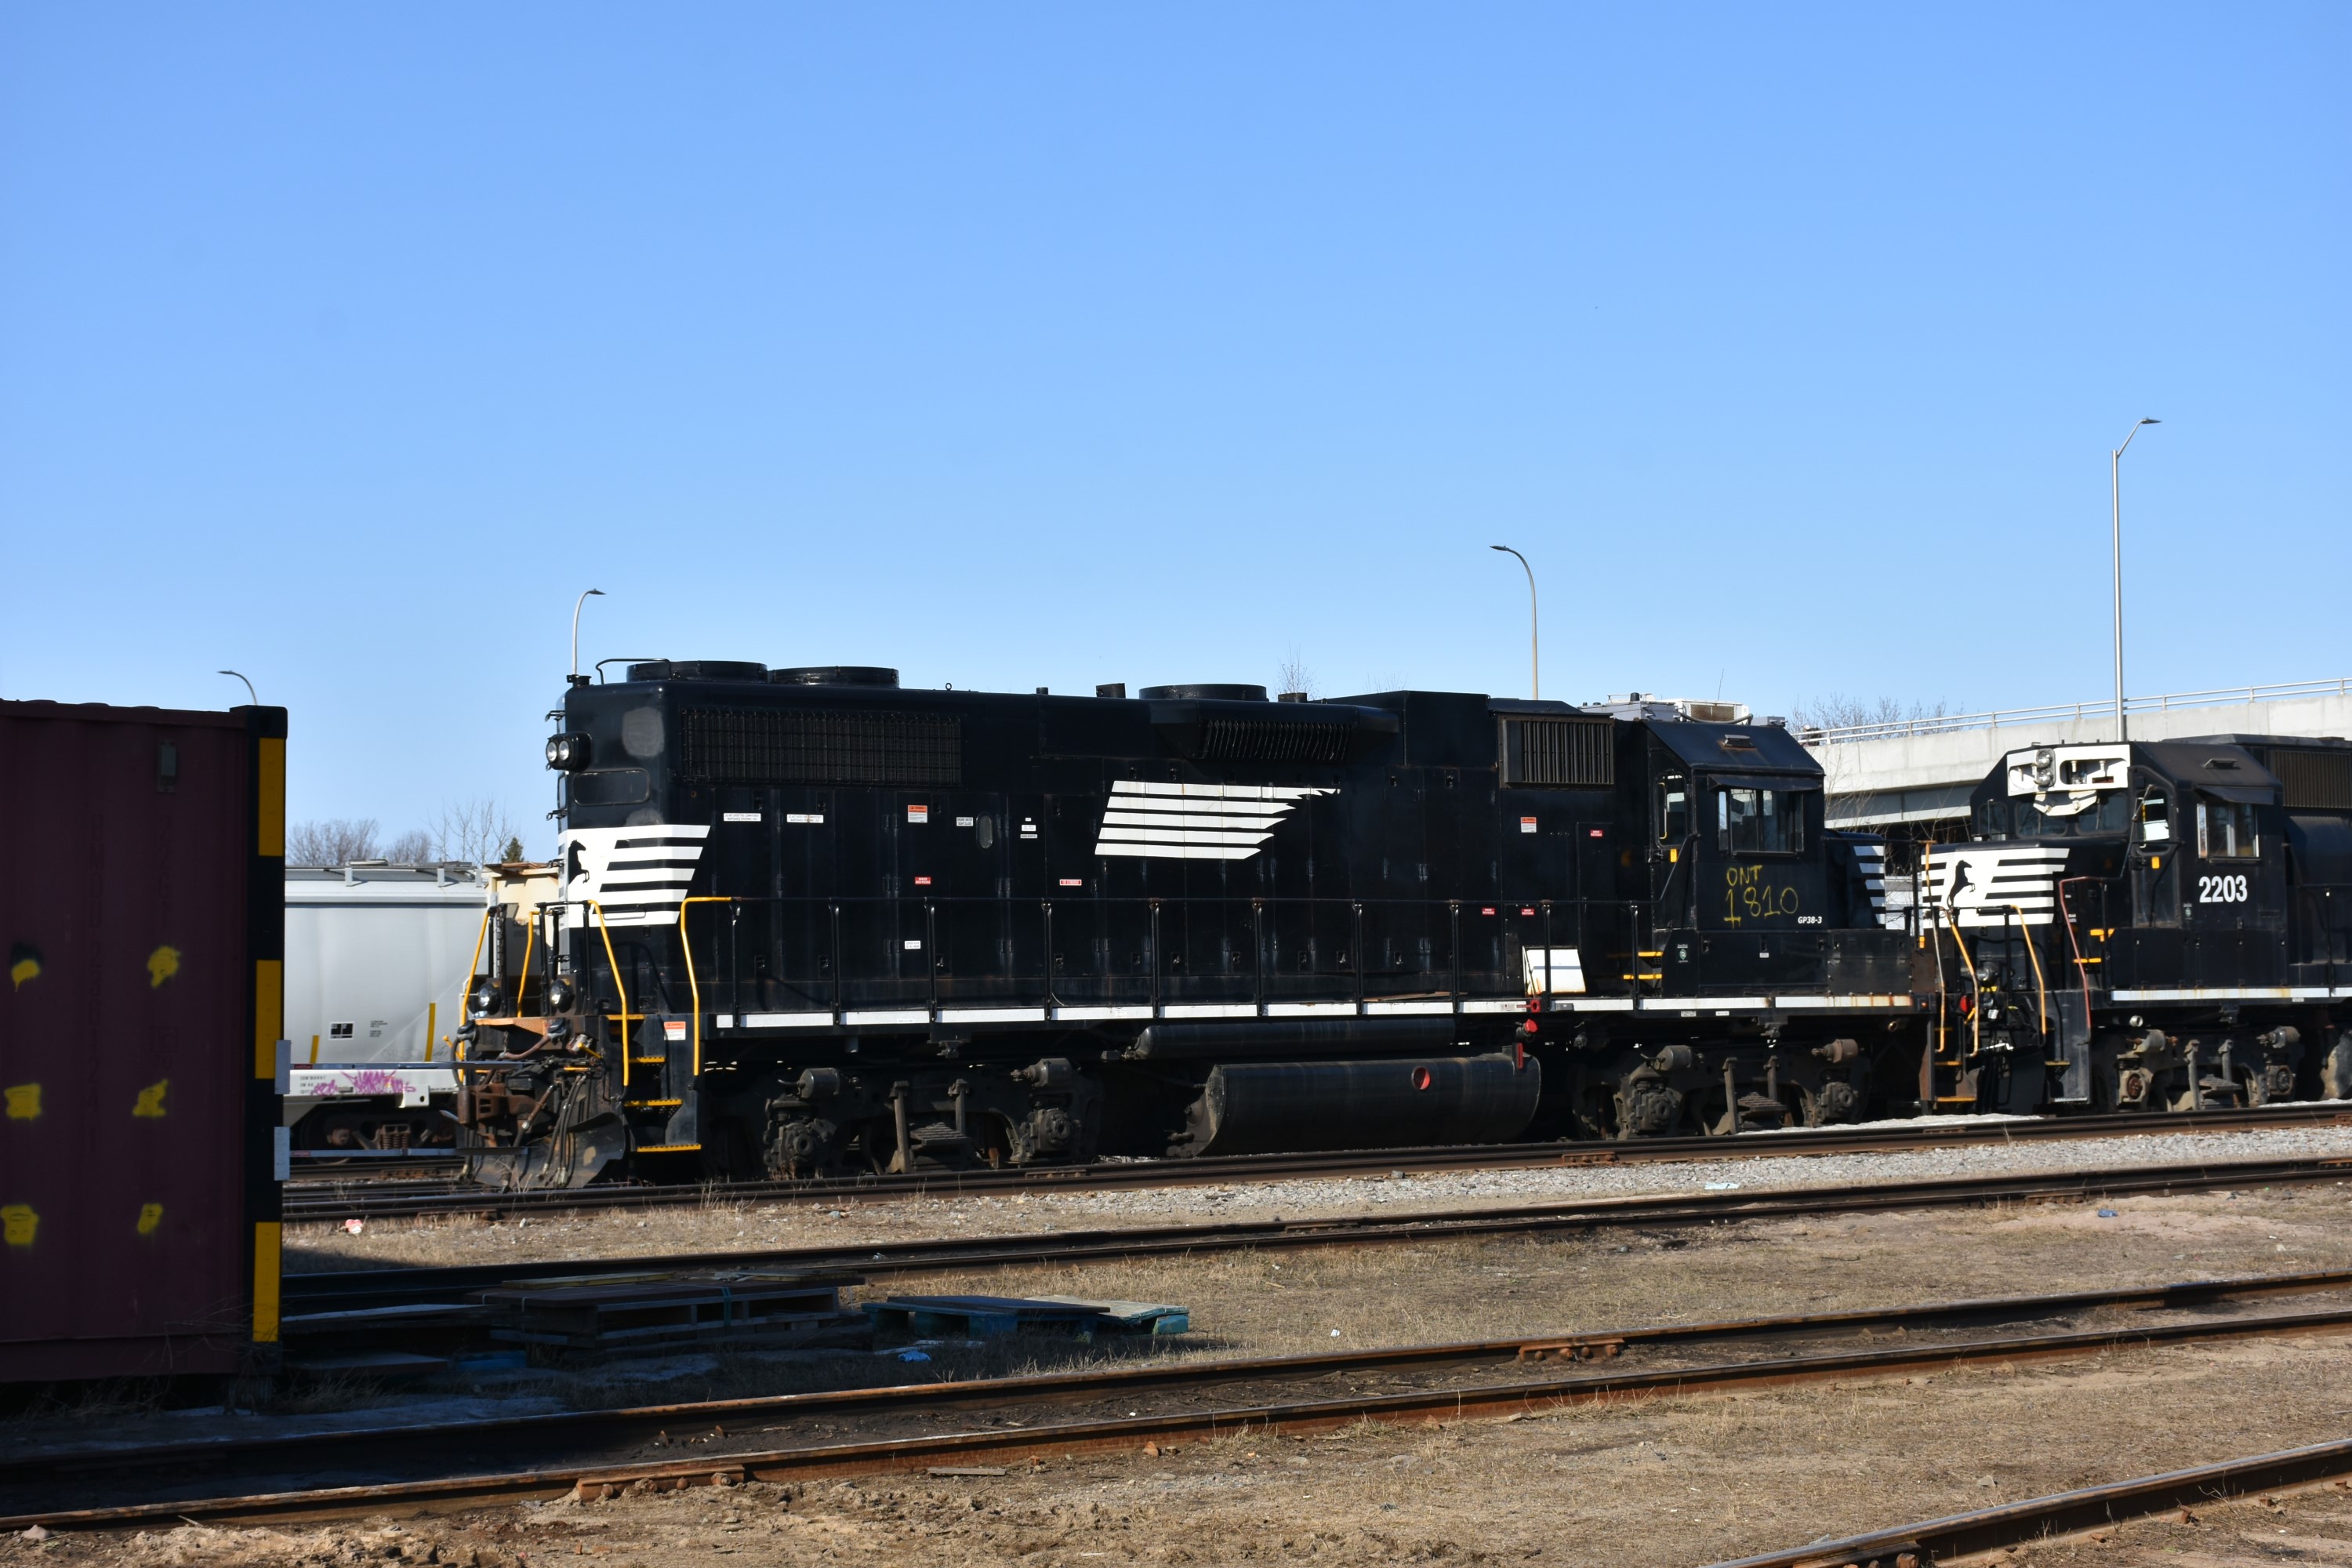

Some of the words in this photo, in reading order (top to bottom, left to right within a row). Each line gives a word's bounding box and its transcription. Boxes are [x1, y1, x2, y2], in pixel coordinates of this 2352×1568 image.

[89, 812, 105, 928] BMOU
[1726, 865, 1762, 887] ONT
[2198, 874, 2248, 903] 2203
[1724, 885, 1798, 928] 1810
[1798, 916, 1823, 924] GP38-3
